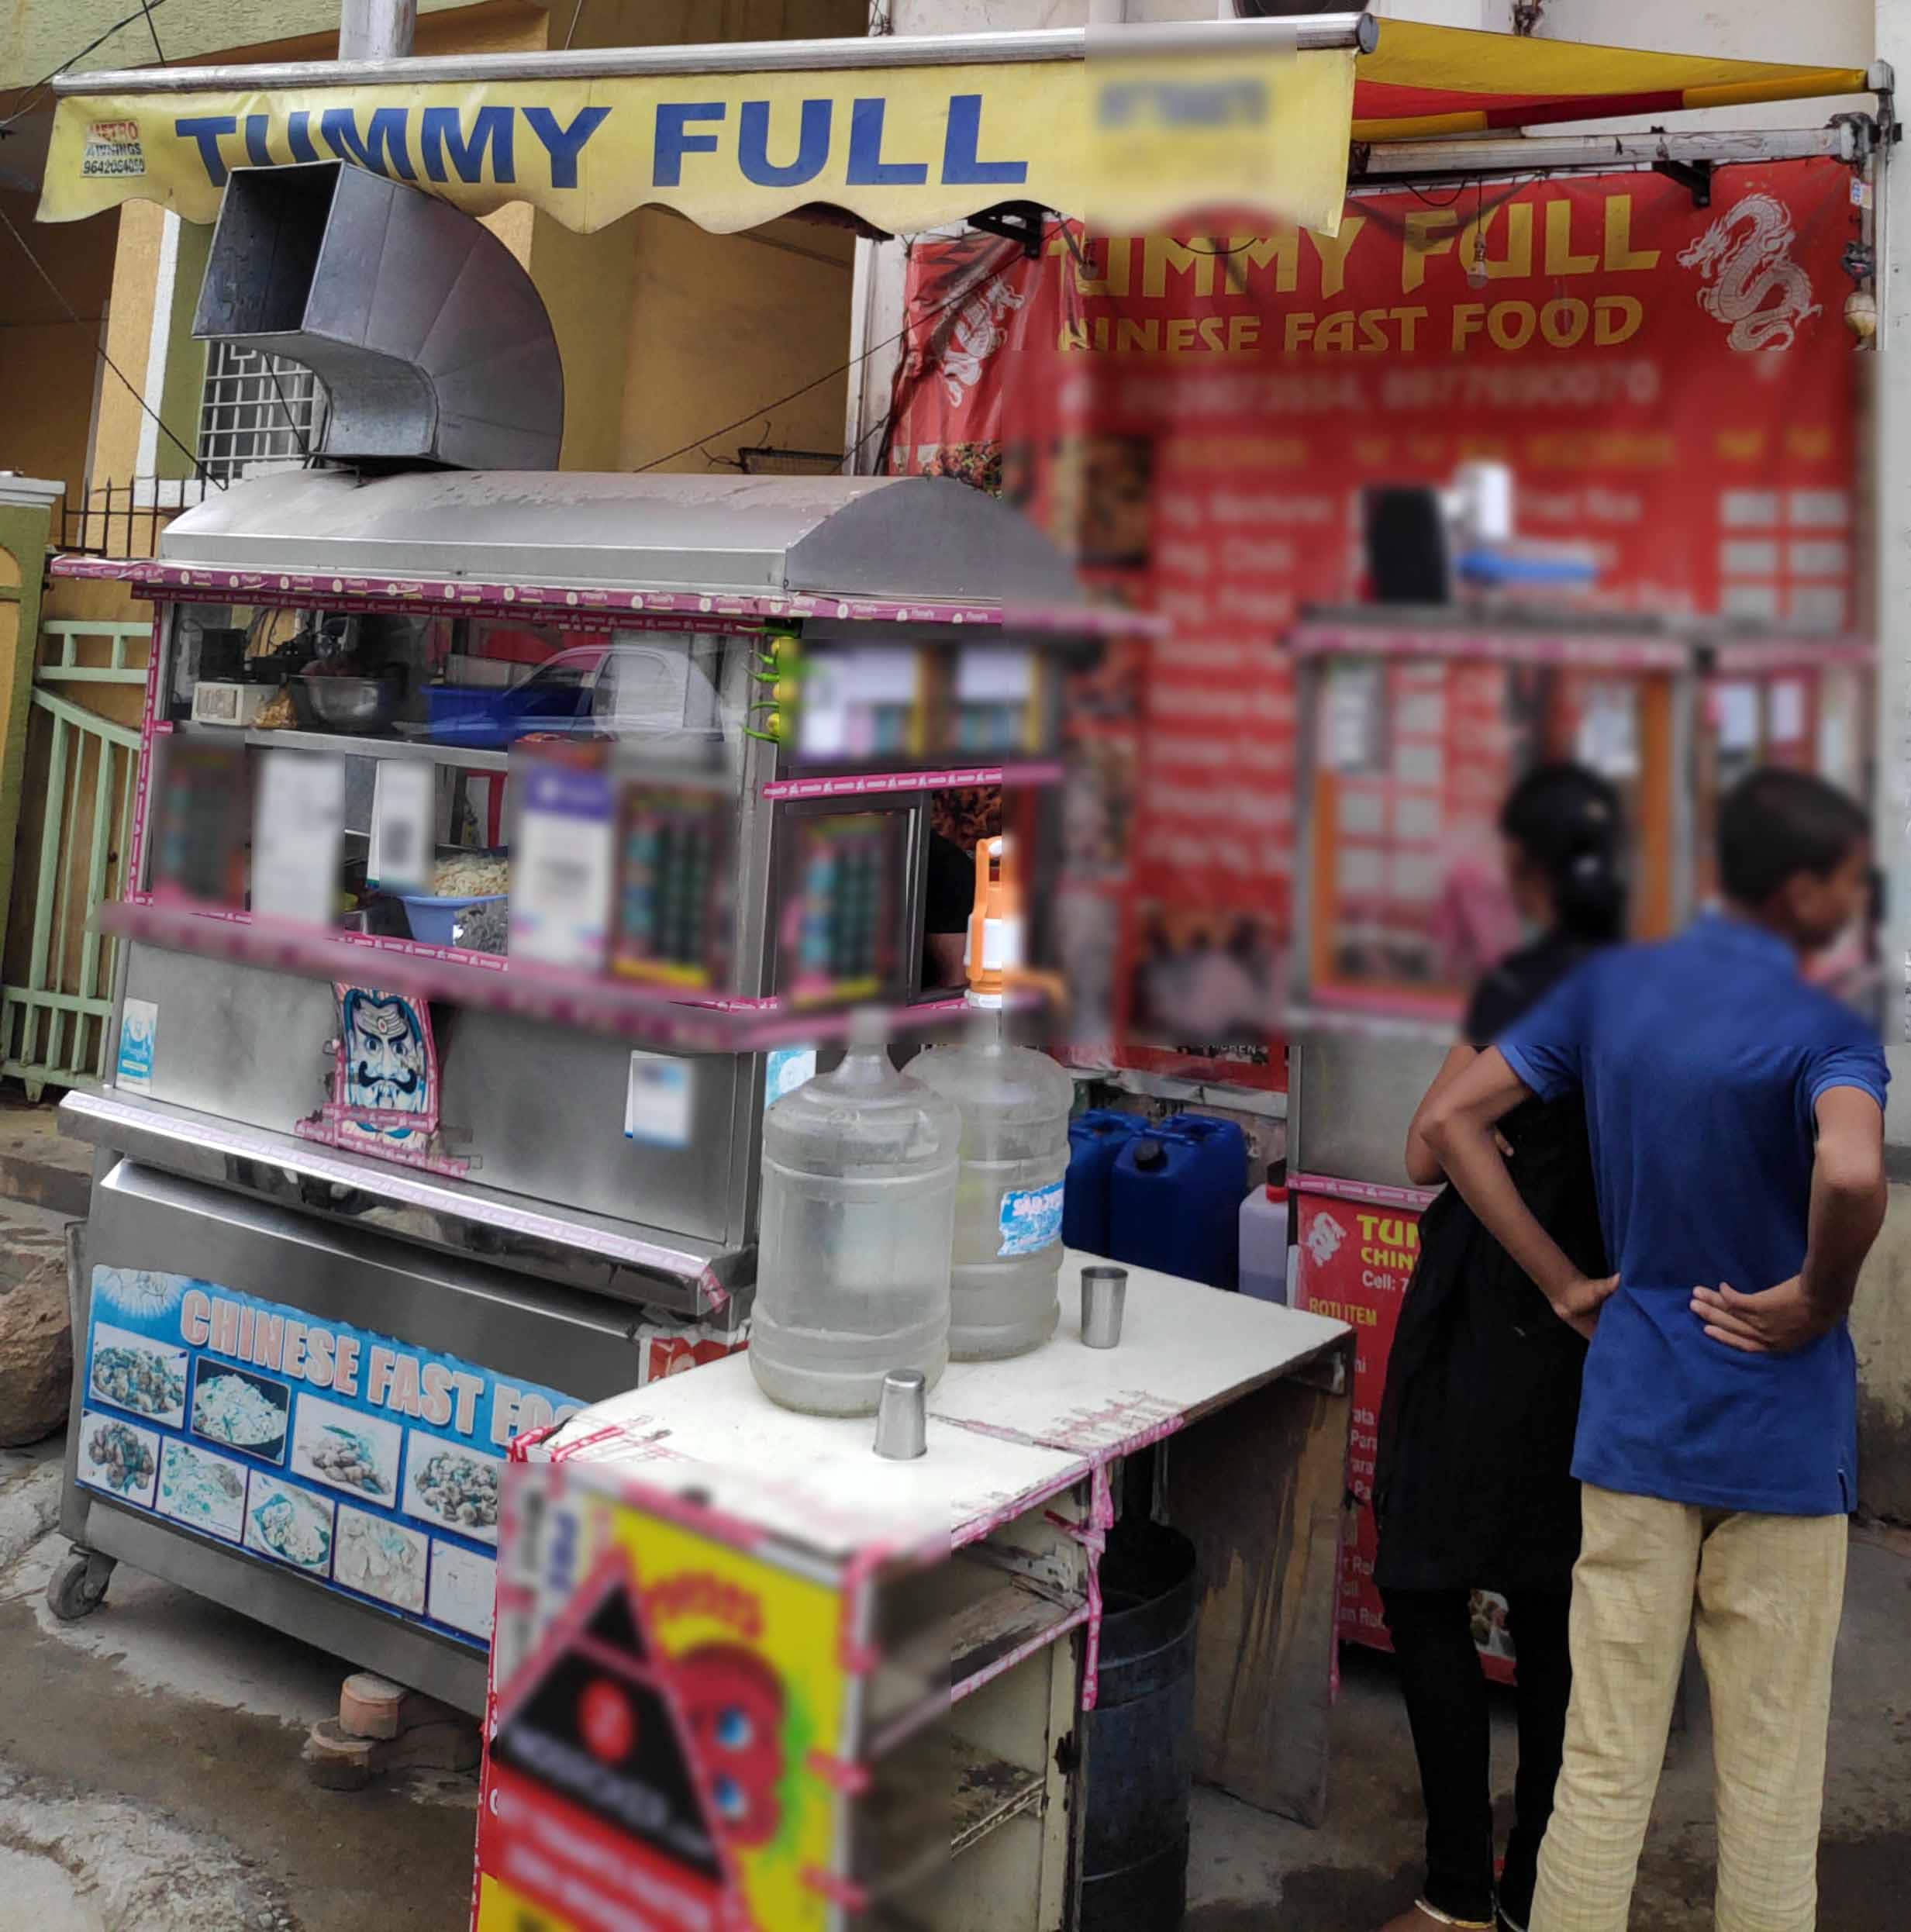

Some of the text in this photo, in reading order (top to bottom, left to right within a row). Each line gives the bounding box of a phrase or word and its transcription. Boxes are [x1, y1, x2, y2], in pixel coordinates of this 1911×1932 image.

[176, 106, 612, 188] TUMMY
[652, 95, 1028, 187] FULL
[1402, 195, 1661, 294] FULL
[1285, 307, 1429, 352] FAST
[1451, 295, 1643, 351] FOOD
[1361, 1247, 1418, 1271] CHIN
[1362, 1270, 1396, 1291] Cell:
[1309, 1296, 1377, 1327] ROTI ITEM
[181, 1289, 360, 1396] CHINESE
[367, 1344, 484, 1434] FAST
